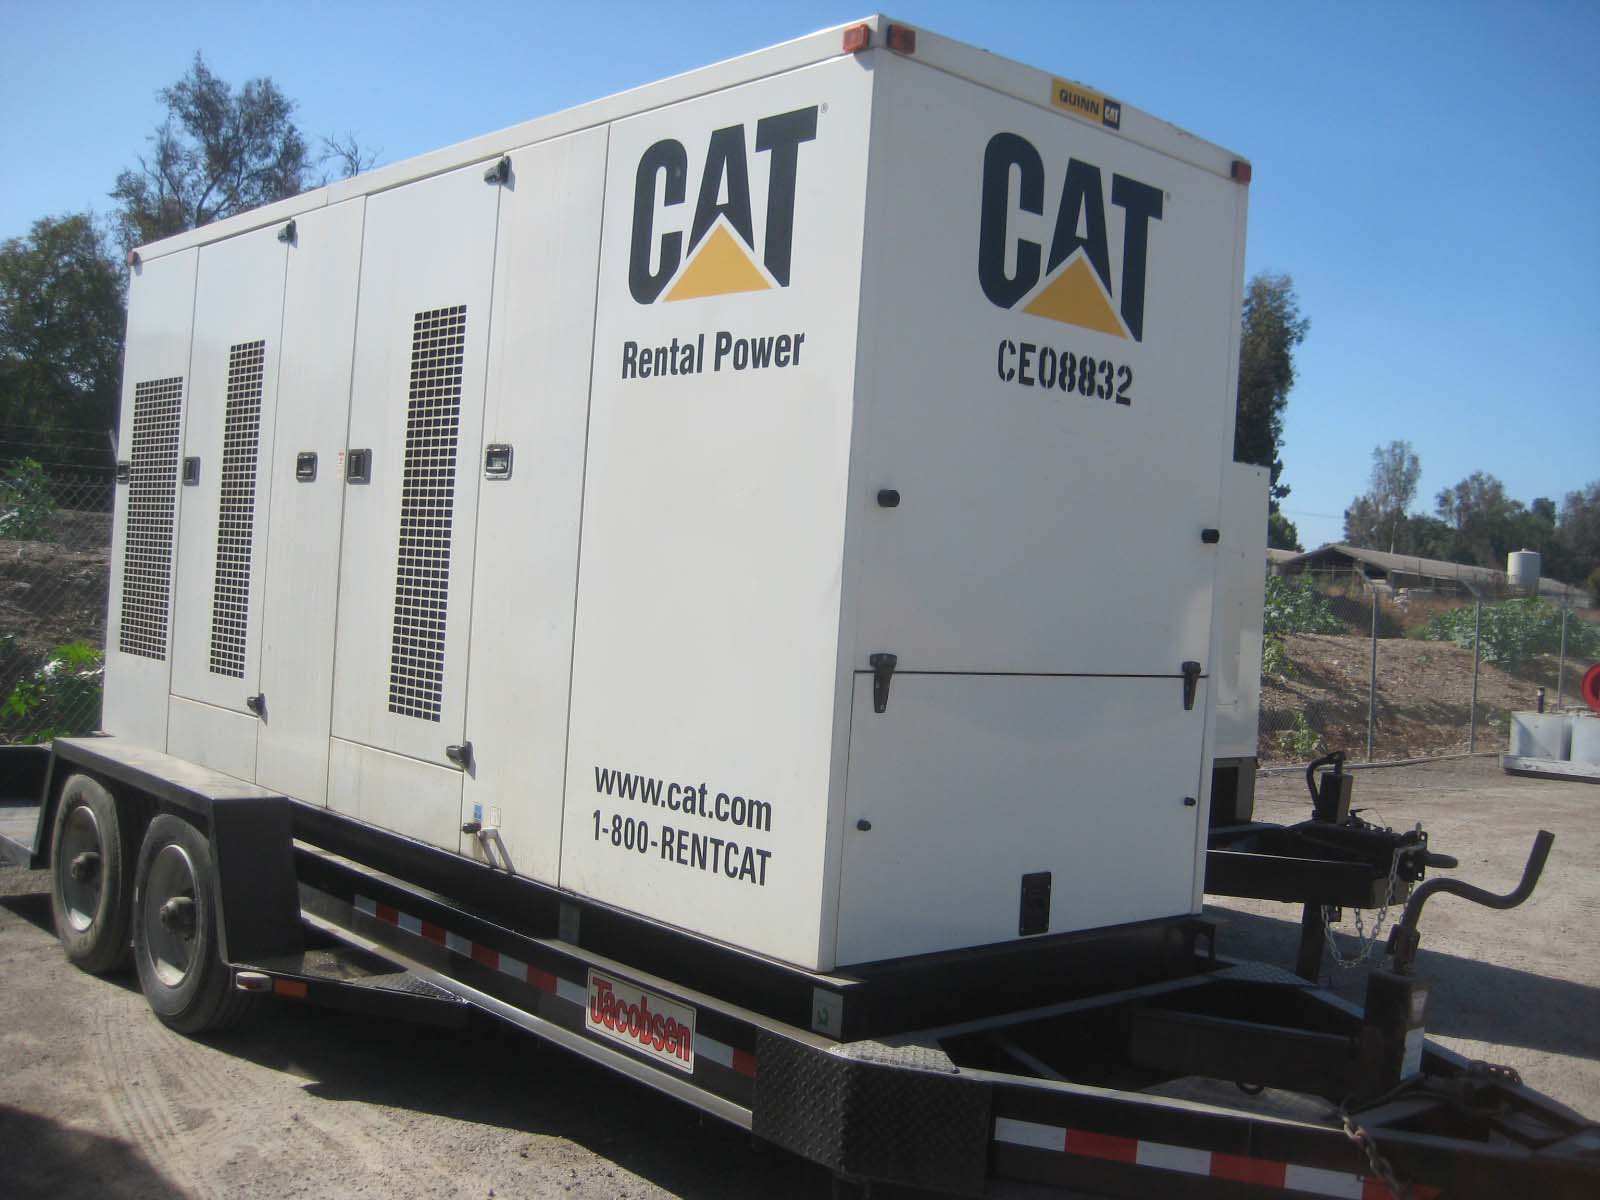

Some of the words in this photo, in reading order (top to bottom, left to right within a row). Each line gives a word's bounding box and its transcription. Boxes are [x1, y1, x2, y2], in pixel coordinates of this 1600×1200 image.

[1060, 88, 1099, 115] QUINN
[628, 105, 818, 305] CAT
[978, 132, 1163, 342] CAT
[622, 333, 704, 379] Rental
[713, 331, 805, 372] Power
[998, 339, 1132, 406] CE08832
[594, 766, 772, 832] www.cat.com
[593, 809, 772, 886] 1-800-RENTCAT
[590, 977, 690, 1062] Jacobsen
